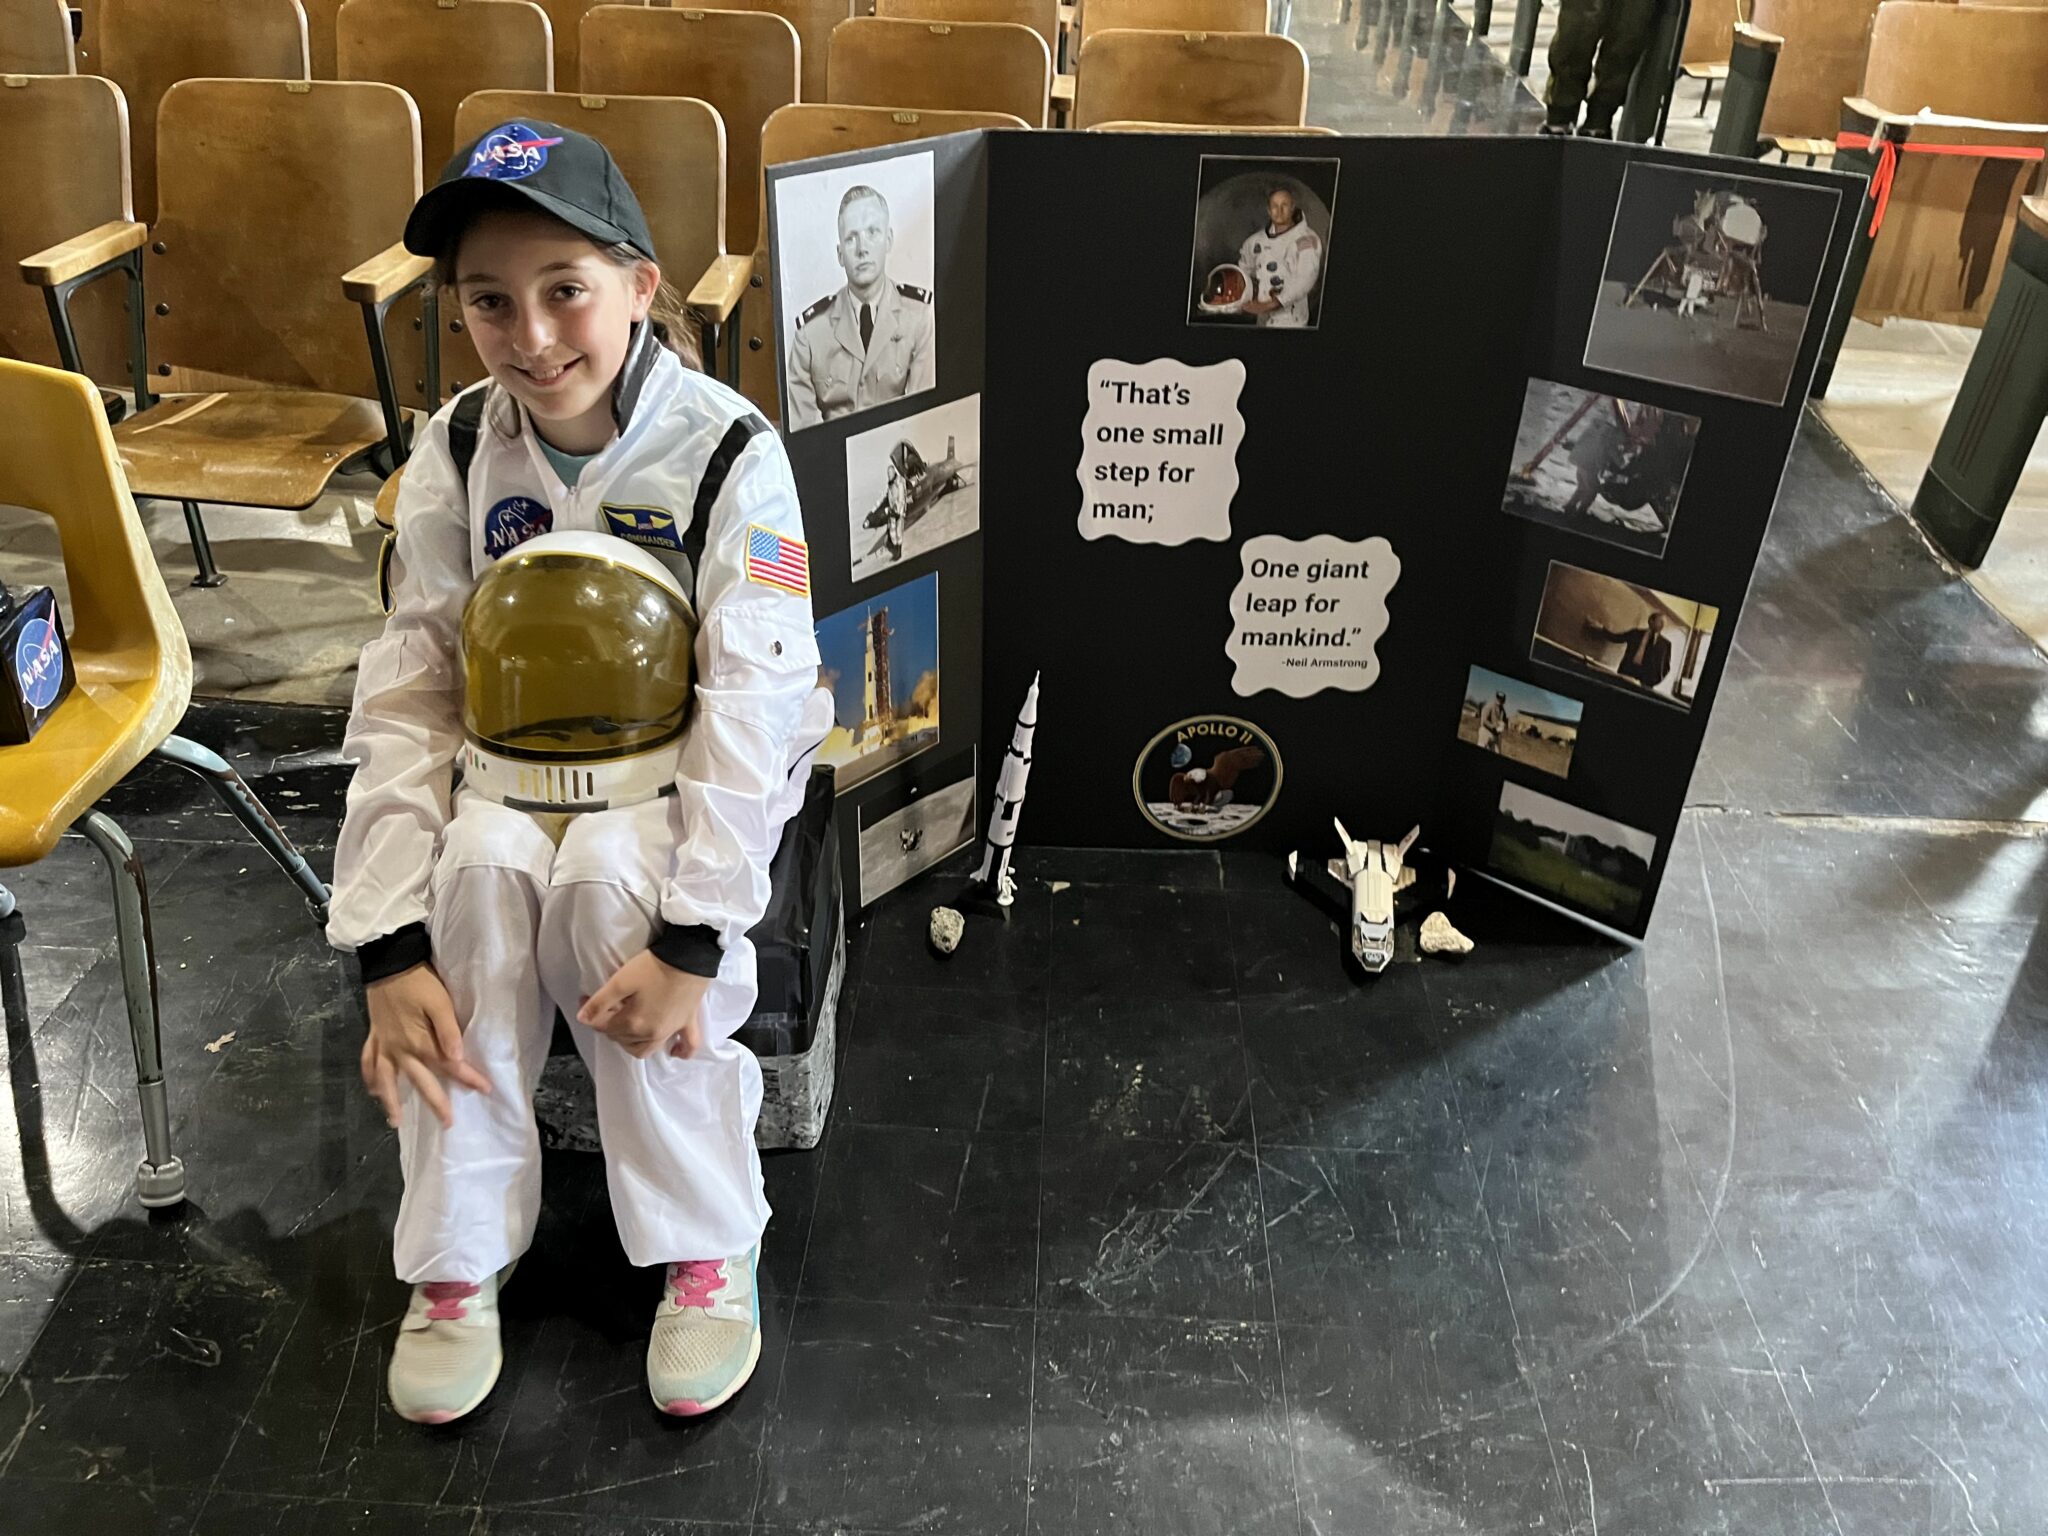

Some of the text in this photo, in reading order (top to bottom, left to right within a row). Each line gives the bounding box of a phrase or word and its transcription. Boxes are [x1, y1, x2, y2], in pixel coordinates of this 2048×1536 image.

[474, 145, 541, 166] NASA
[1100, 379, 1191, 405] “That’s
[1096, 423, 1224, 445] one small
[1094, 460, 1195, 487] step for
[1092, 502, 1154, 524] man;
[491, 524, 547, 548] NASA
[1250, 558, 1369, 583] One giant
[1246, 592, 1340, 617] leap for
[1241, 627, 1362, 647] mankind.”
[21, 639, 59, 690] NASA
[1282, 658, 1368, 669] -Neil Armstrong
[1177, 723, 1238, 743] APOLLO
